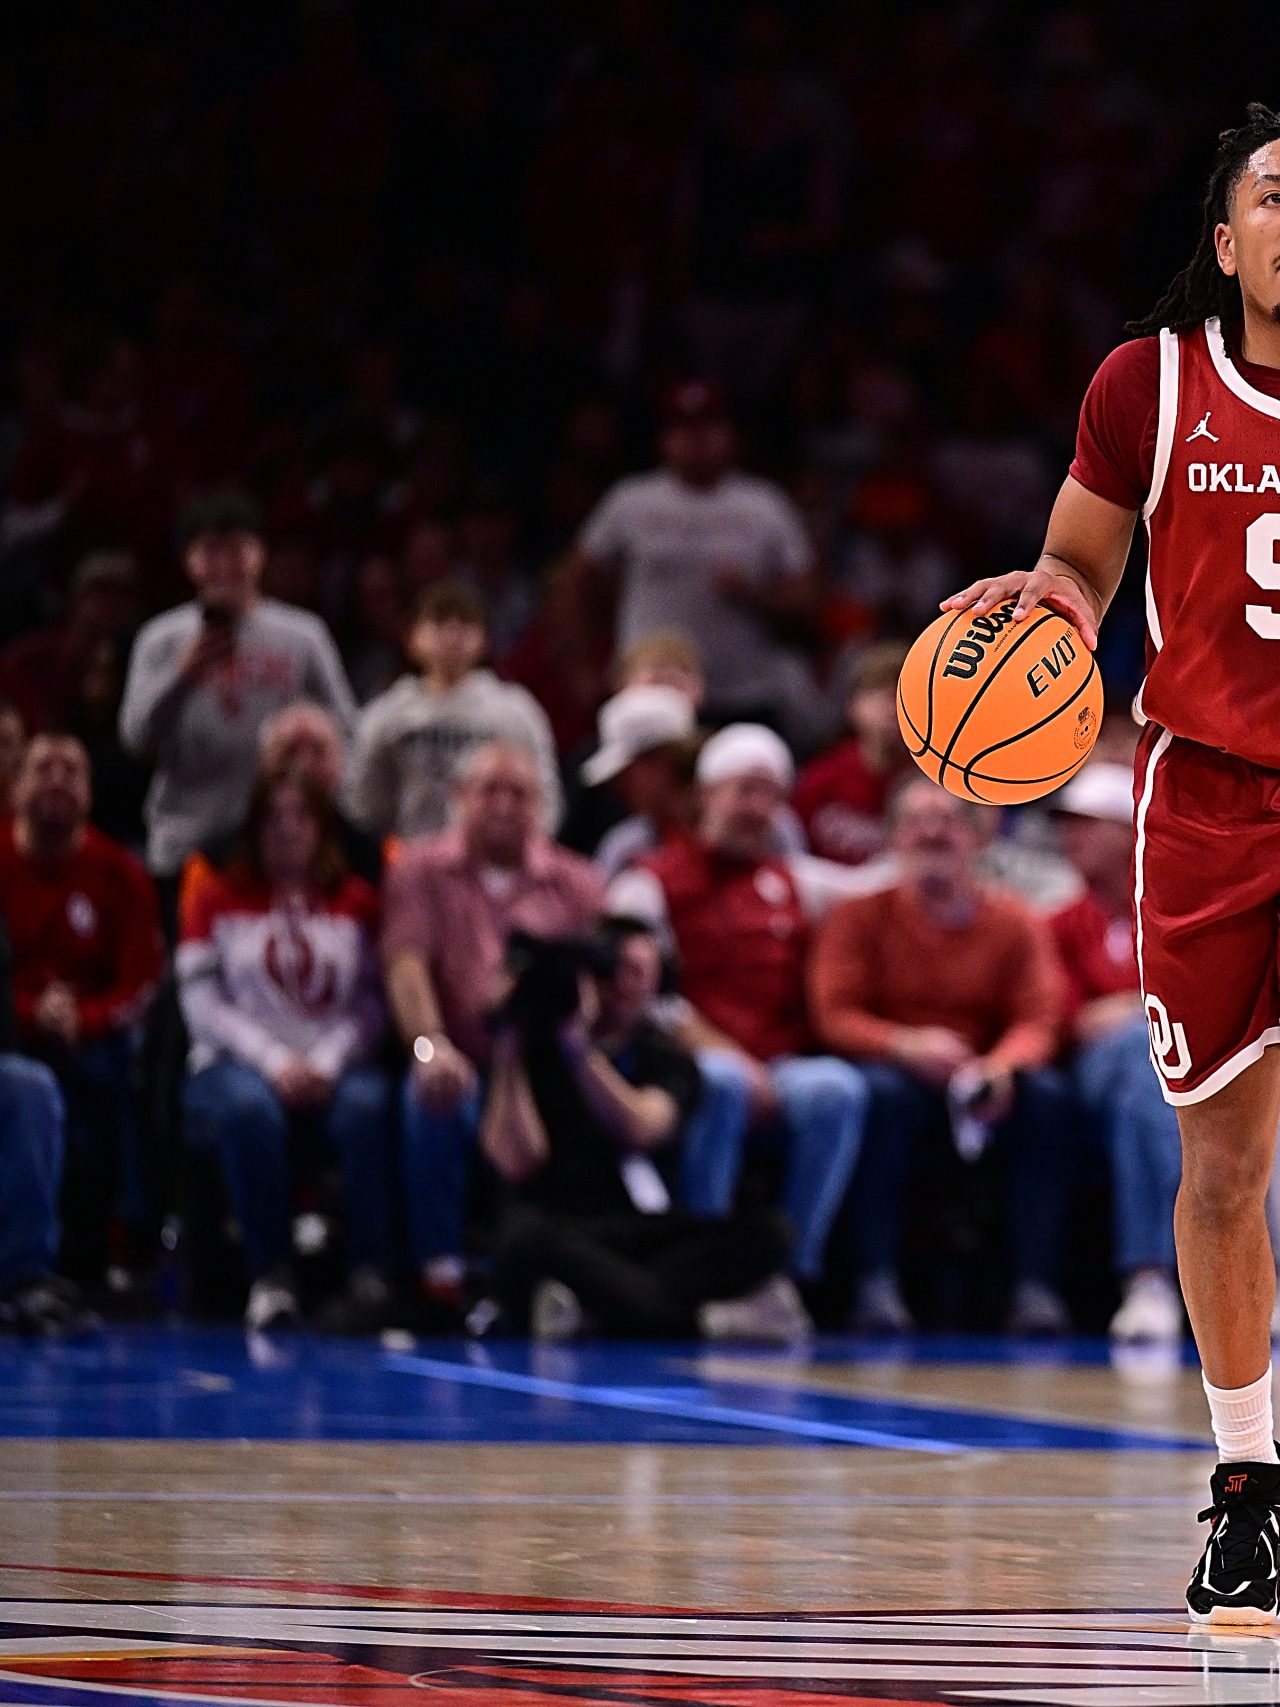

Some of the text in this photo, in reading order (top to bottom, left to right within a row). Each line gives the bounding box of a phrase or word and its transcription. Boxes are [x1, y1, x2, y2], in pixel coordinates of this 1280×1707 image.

[942, 601, 1019, 680] Wilso
[1026, 635, 1077, 698] EVO
[1145, 993, 1192, 1079] OU
